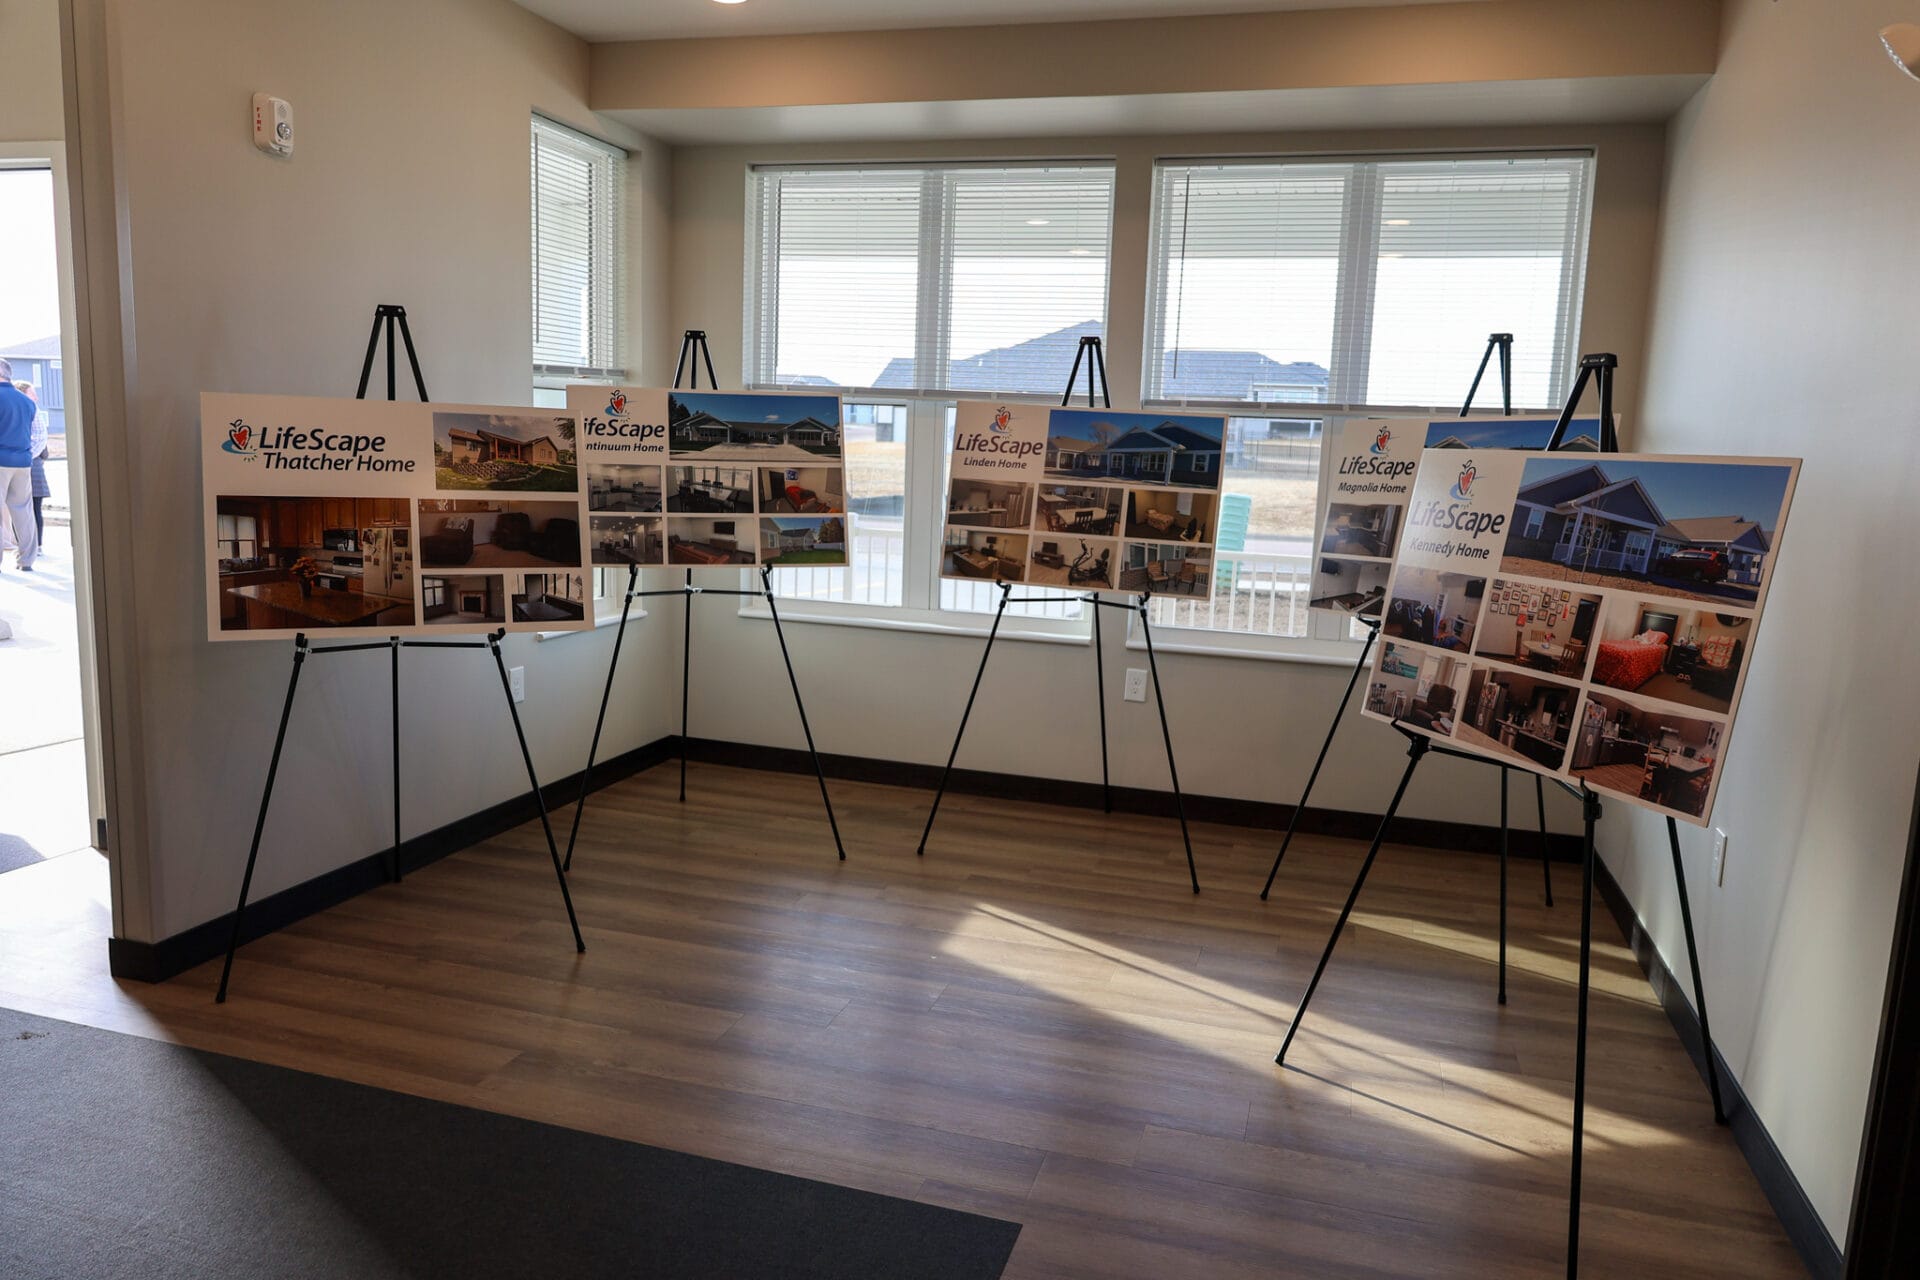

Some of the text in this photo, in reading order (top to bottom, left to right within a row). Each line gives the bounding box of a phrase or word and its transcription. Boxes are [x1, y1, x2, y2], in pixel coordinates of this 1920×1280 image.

[584, 417, 665, 441] ifeScape
[259, 426, 386, 457] LifeScape
[585, 441, 664, 453] ntinuum Home
[955, 433, 1043, 458] LifeScape
[264, 451, 415, 473] Thatcher Home
[964, 457, 1027, 469] Linden Home
[1339, 456, 1415, 480] LifeScape
[1338, 482, 1406, 494] Magnolia Home
[1410, 501, 1505, 539] LifeScape
[1410, 538, 1490, 560] Kennedy Home
